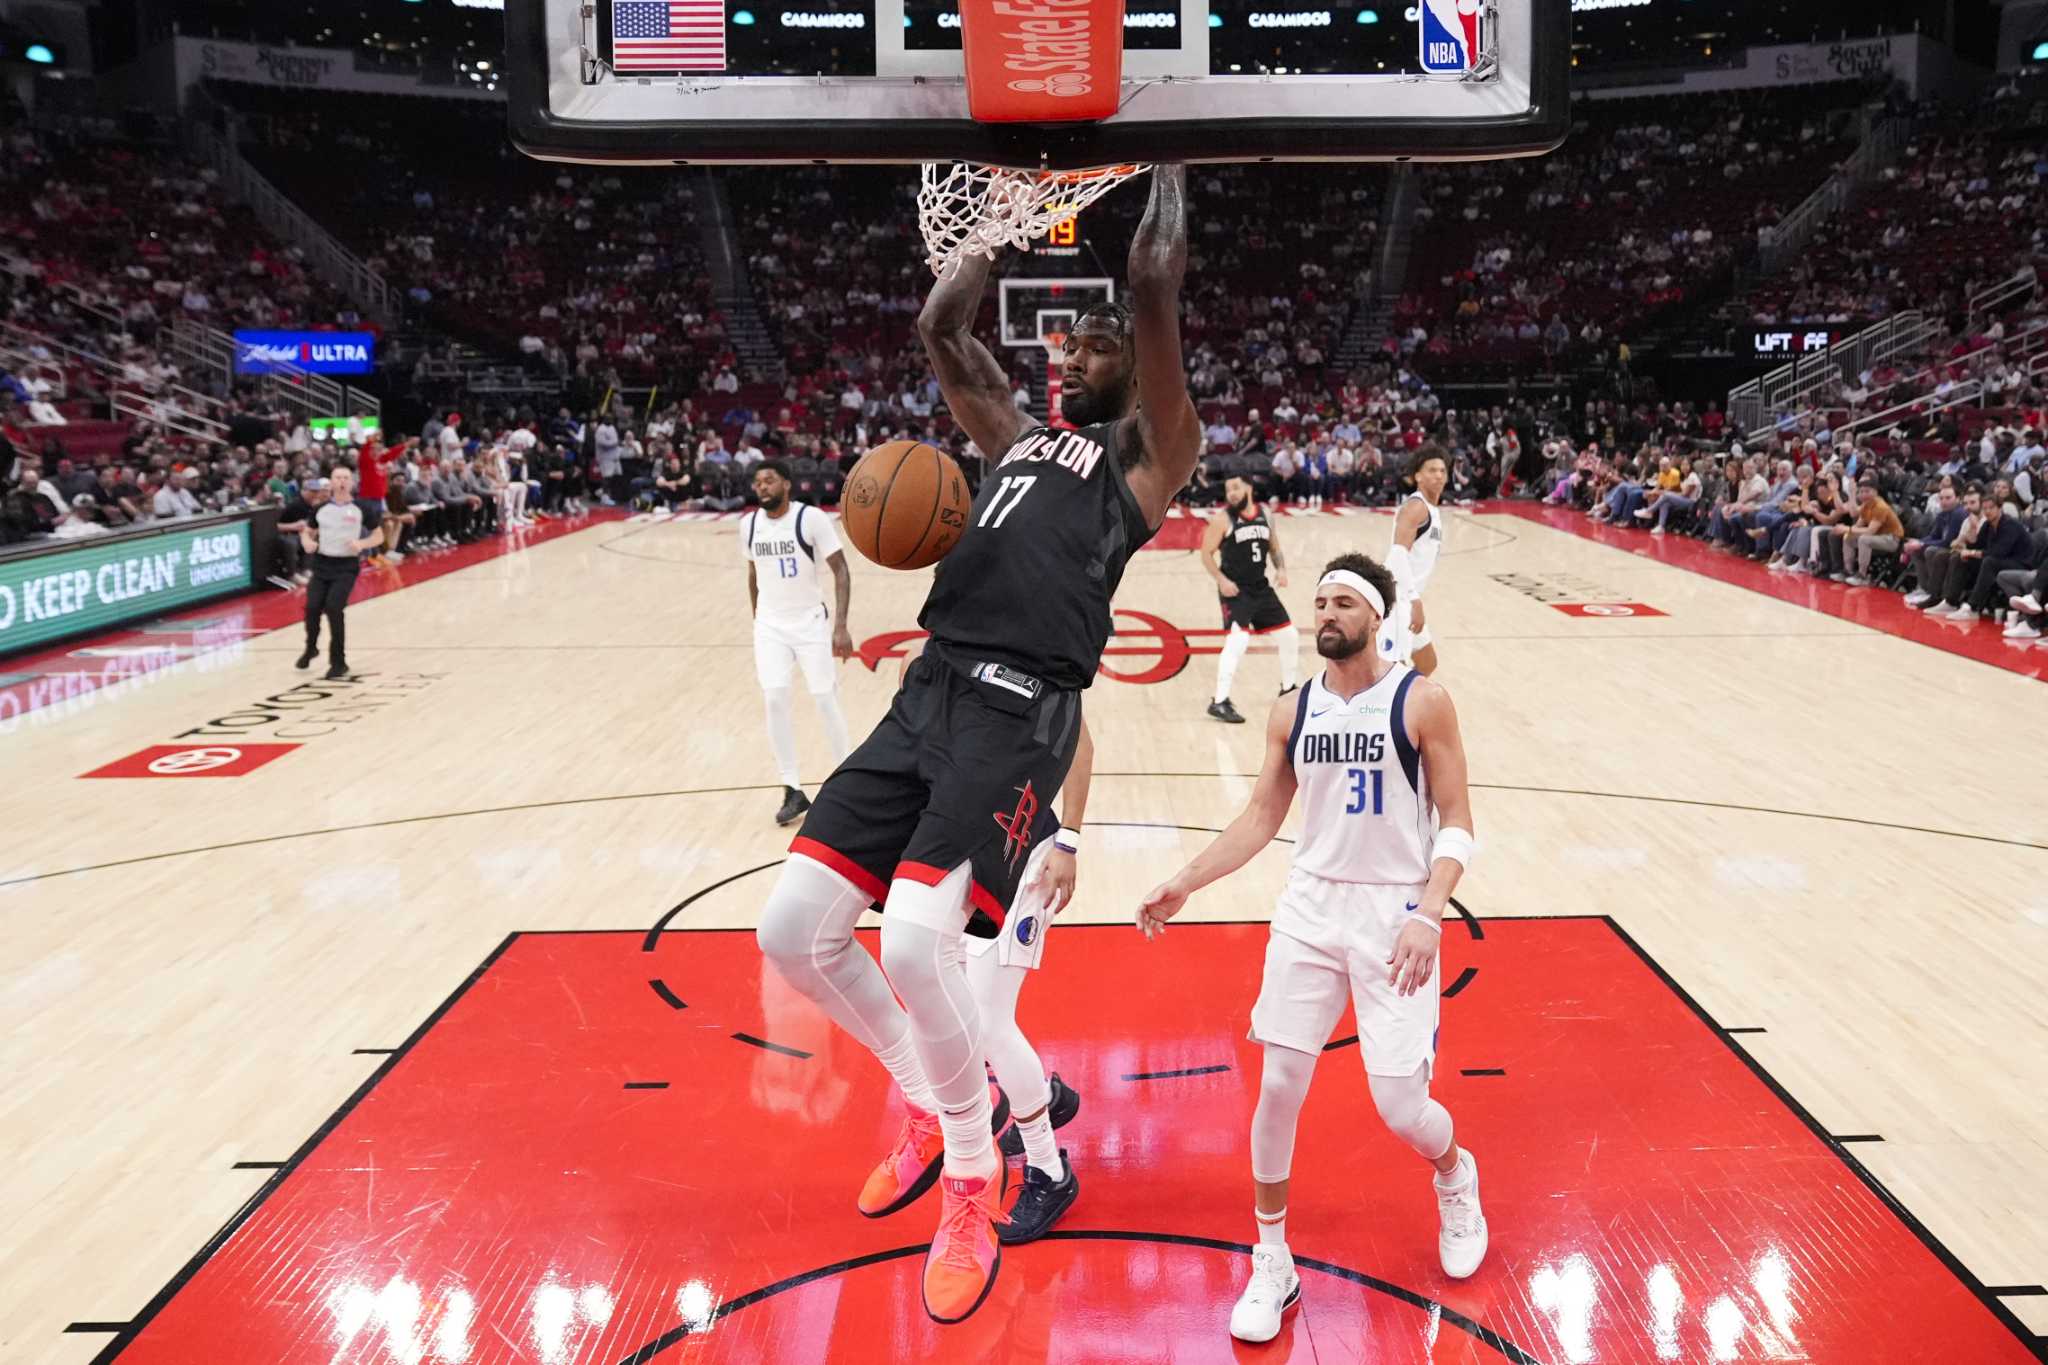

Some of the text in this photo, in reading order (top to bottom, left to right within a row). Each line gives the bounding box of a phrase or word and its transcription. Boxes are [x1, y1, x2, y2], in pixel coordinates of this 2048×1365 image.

[780, 12, 865, 28] CASAMIGOS
[1249, 11, 1331, 28] CASAMIGOS
[1429, 42, 1458, 64] NBA
[1049, 217, 1075, 245] 19
[312, 344, 367, 361] ULTRA
[977, 475, 1038, 529] 17
[755, 541, 795, 556] DALLAS
[1251, 542, 1262, 562] 5
[780, 557, 797, 578] 13
[23, 569, 92, 623] KEEP
[1303, 732, 1385, 763] DALLAS
[1346, 769, 1383, 815] 31
